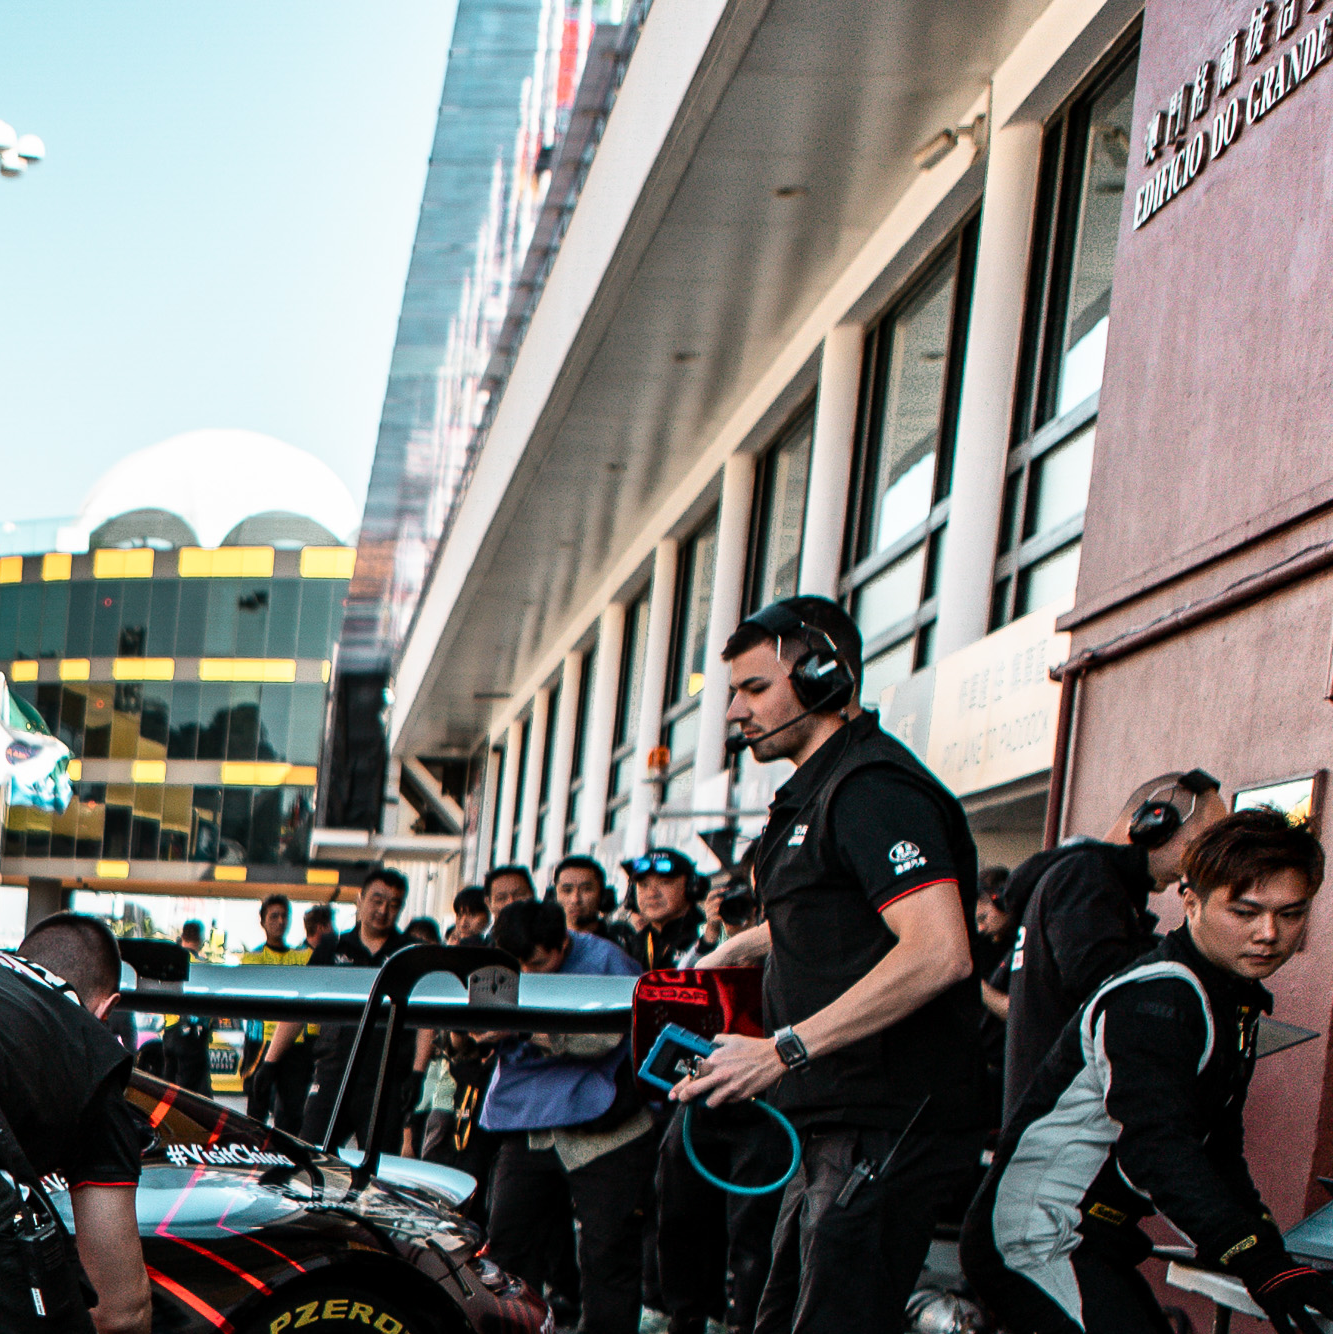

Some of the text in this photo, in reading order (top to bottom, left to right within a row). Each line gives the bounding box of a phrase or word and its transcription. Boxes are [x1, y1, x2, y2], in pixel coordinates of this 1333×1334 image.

[1210, 97, 1240, 161] DO
[1245, 12, 1333, 125] GRANDE
[166, 1143, 296, 1167] #VisitChina
